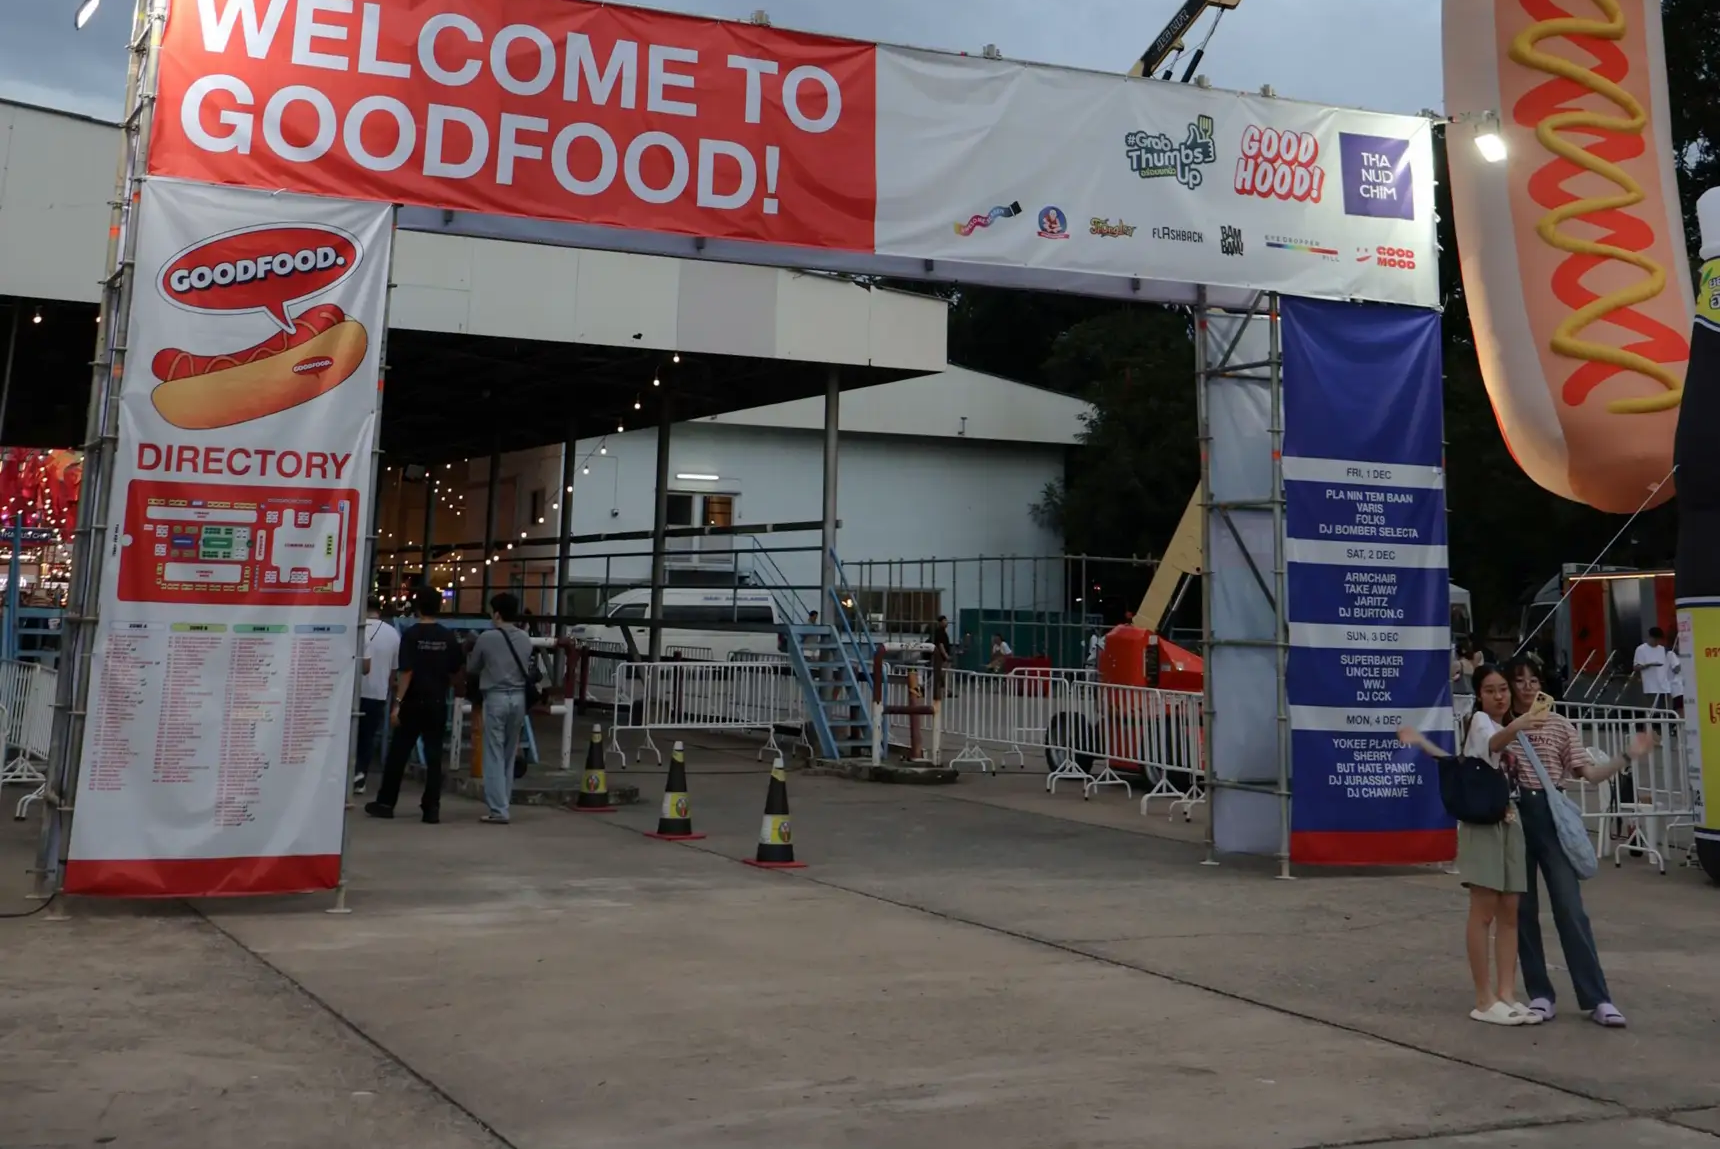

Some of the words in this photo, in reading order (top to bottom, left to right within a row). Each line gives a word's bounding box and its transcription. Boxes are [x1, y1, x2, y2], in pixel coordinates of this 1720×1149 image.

[727, 53, 842, 135] TO
[179, 73, 782, 215] GOODFOOD!
[1126, 131, 1172, 151] #Grab
[1241, 125, 1319, 167] GOOD
[1127, 144, 1204, 170] Thumbs
[1360, 152, 1391, 167] THA
[1177, 156, 1201, 189] Up
[1361, 168, 1394, 184] NUD
[1234, 157, 1325, 203] HOOD!
[1359, 184, 1398, 201] CHIM
[1152, 226, 1204, 243] FLASHBACK
[1220, 225, 1242, 242] BAM
[1376, 245, 1415, 259] GOOD
[169, 246, 346, 292] GOODFOOD.
[1377, 256, 1416, 270] MOOD
[137, 442, 352, 480] DIRECTORY
[1346, 467, 1363, 479] FRI,
[1366, 469, 1370, 478] 1
[1373, 469, 1392, 480] DEC
[1326, 489, 1345, 500] PLA
[1347, 490, 1363, 501] NIN
[1365, 491, 1384, 502] TEM
[1386, 493, 1413, 503] BAAN
[1356, 503, 1383, 513] VARIS
[1355, 514, 1385, 525] FOLK9
[1319, 524, 1333, 535] DJ
[1335, 525, 1377, 536] BOMBER
[1379, 527, 1419, 538] SELECTA
[1346, 549, 1366, 560] SAT,
[1368, 549, 1375, 559] 2
[1376, 550, 1396, 560] DEC
[1344, 572, 1396, 583] ARMCHAIR
[1344, 584, 1369, 594] TAKE
[1371, 585, 1397, 595] AWAY
[1354, 596, 1388, 607] JARITZ
[1339, 607, 1351, 617] DJ
[1353, 608, 1404, 619] BURTON.G
[1372, 632, 1378, 642] 3
[1380, 632, 1399, 642] DEC
[1340, 654, 1404, 666] SUPERBAKER
[1346, 667, 1380, 677] UNCLE
[1382, 667, 1399, 678] BEN
[1356, 690, 1370, 701] DJ
[1372, 691, 1392, 701] CCK
[1346, 715, 1372, 726] MON,
[1374, 715, 1381, 725] 4
[1382, 715, 1402, 726] DEC
[1332, 738, 1367, 749] YOKEE
[1353, 751, 1393, 761] SHERRY
[1336, 763, 1356, 773] BUT
[1358, 763, 1383, 773] HATE
[1385, 763, 1416, 774] PANIC
[1328, 775, 1342, 785] DJ
[1343, 775, 1392, 786] JURASSIC
[1394, 775, 1416, 785] PEW
[1416, 775, 1423, 785] &
[1347, 787, 1360, 798] DJ
[1361, 787, 1409, 798] CHAWAVE
